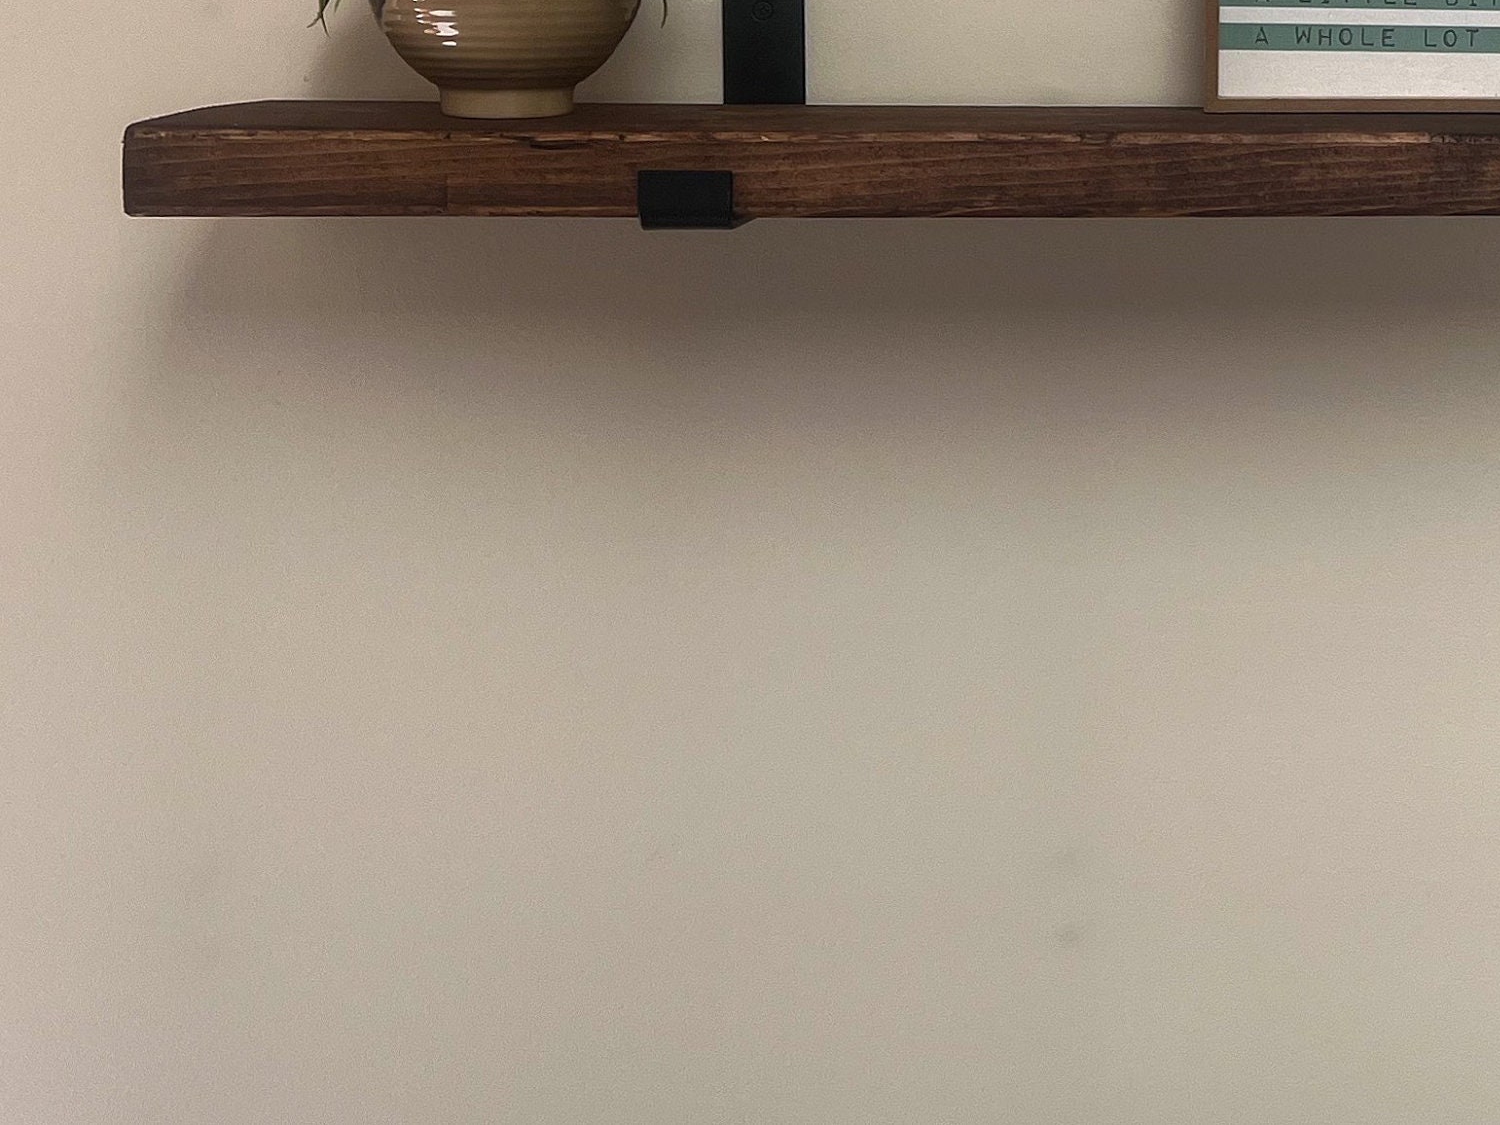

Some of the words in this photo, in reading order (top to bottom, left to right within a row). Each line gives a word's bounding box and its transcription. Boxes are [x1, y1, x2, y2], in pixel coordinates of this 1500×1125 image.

[1254, 26, 1269, 45] A
[1294, 27, 1396, 48] WHOLE
[1424, 28, 1480, 48] LOT
